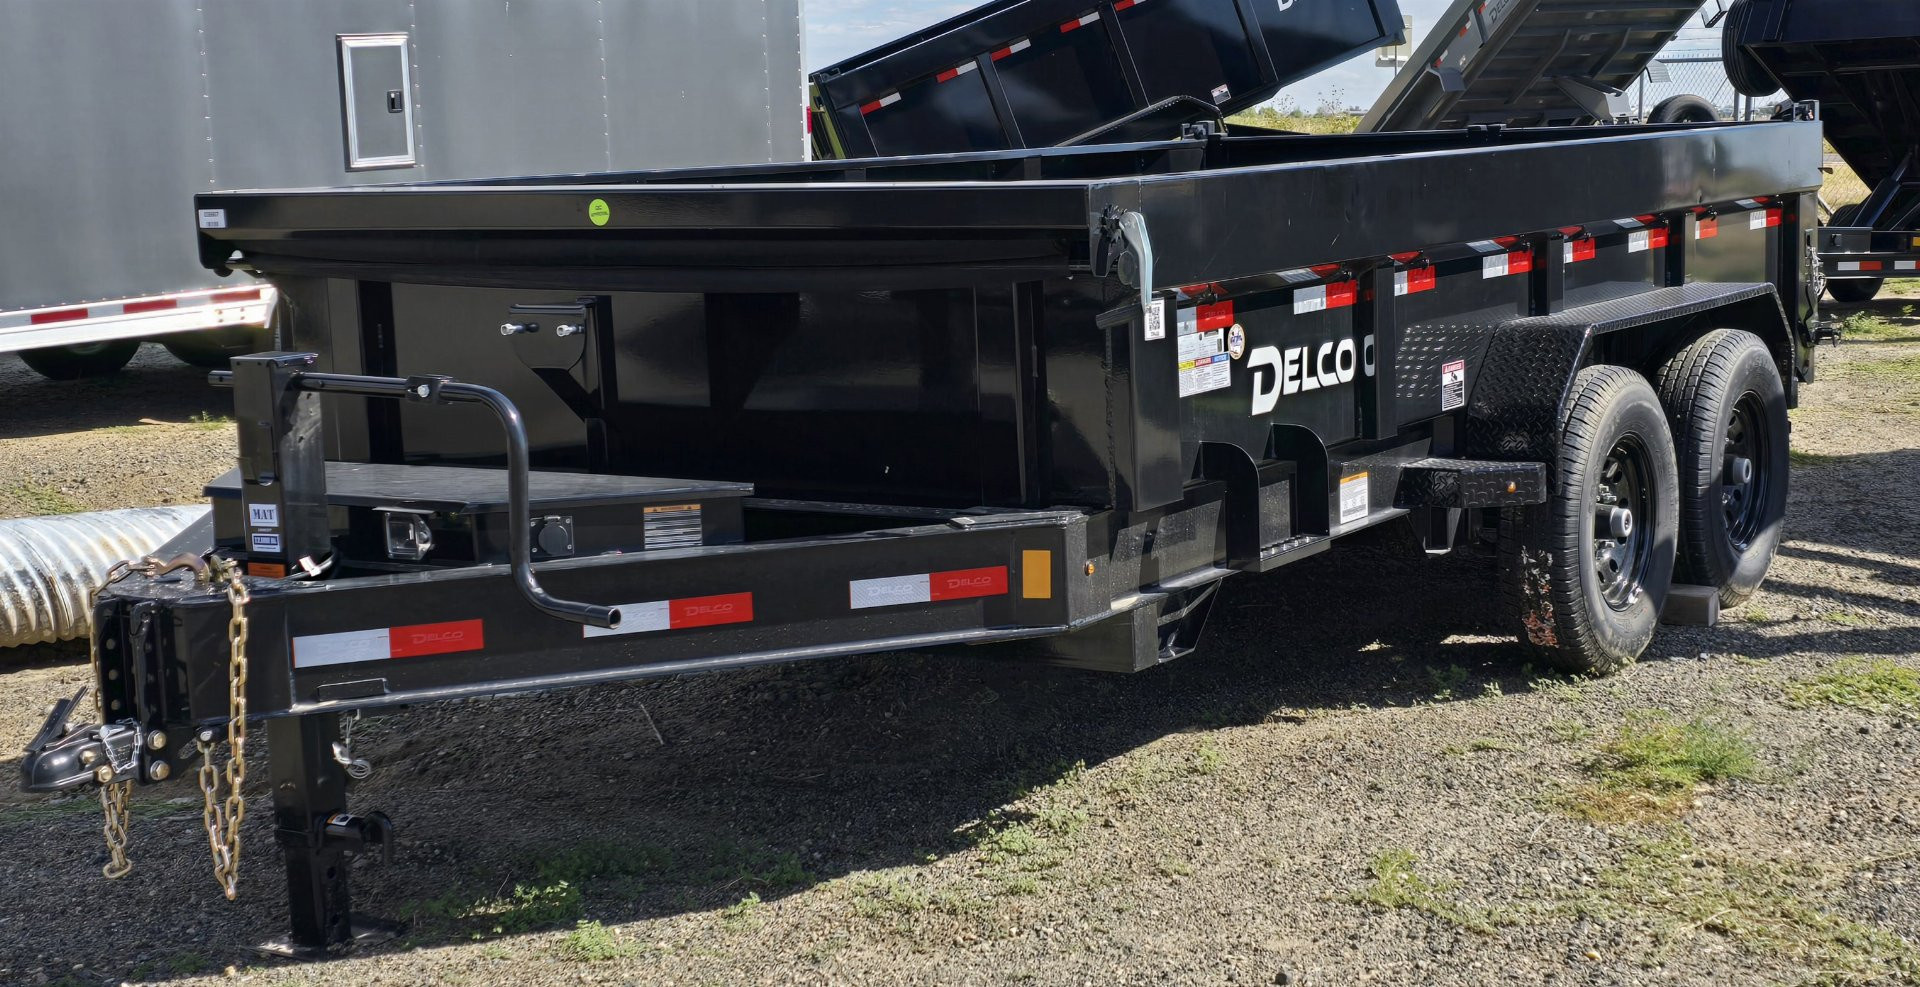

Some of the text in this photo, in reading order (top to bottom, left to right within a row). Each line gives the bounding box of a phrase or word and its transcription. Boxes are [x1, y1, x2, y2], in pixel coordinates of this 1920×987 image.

[1489, 0, 1508, 24] DEL
[1247, 338, 1356, 416] DELCO
[252, 508, 275, 520] MAT
[947, 576, 991, 588] DELCO
[866, 584, 913, 597] DELCO
[683, 603, 734, 617] DELCO
[411, 631, 464, 644] DELCO
